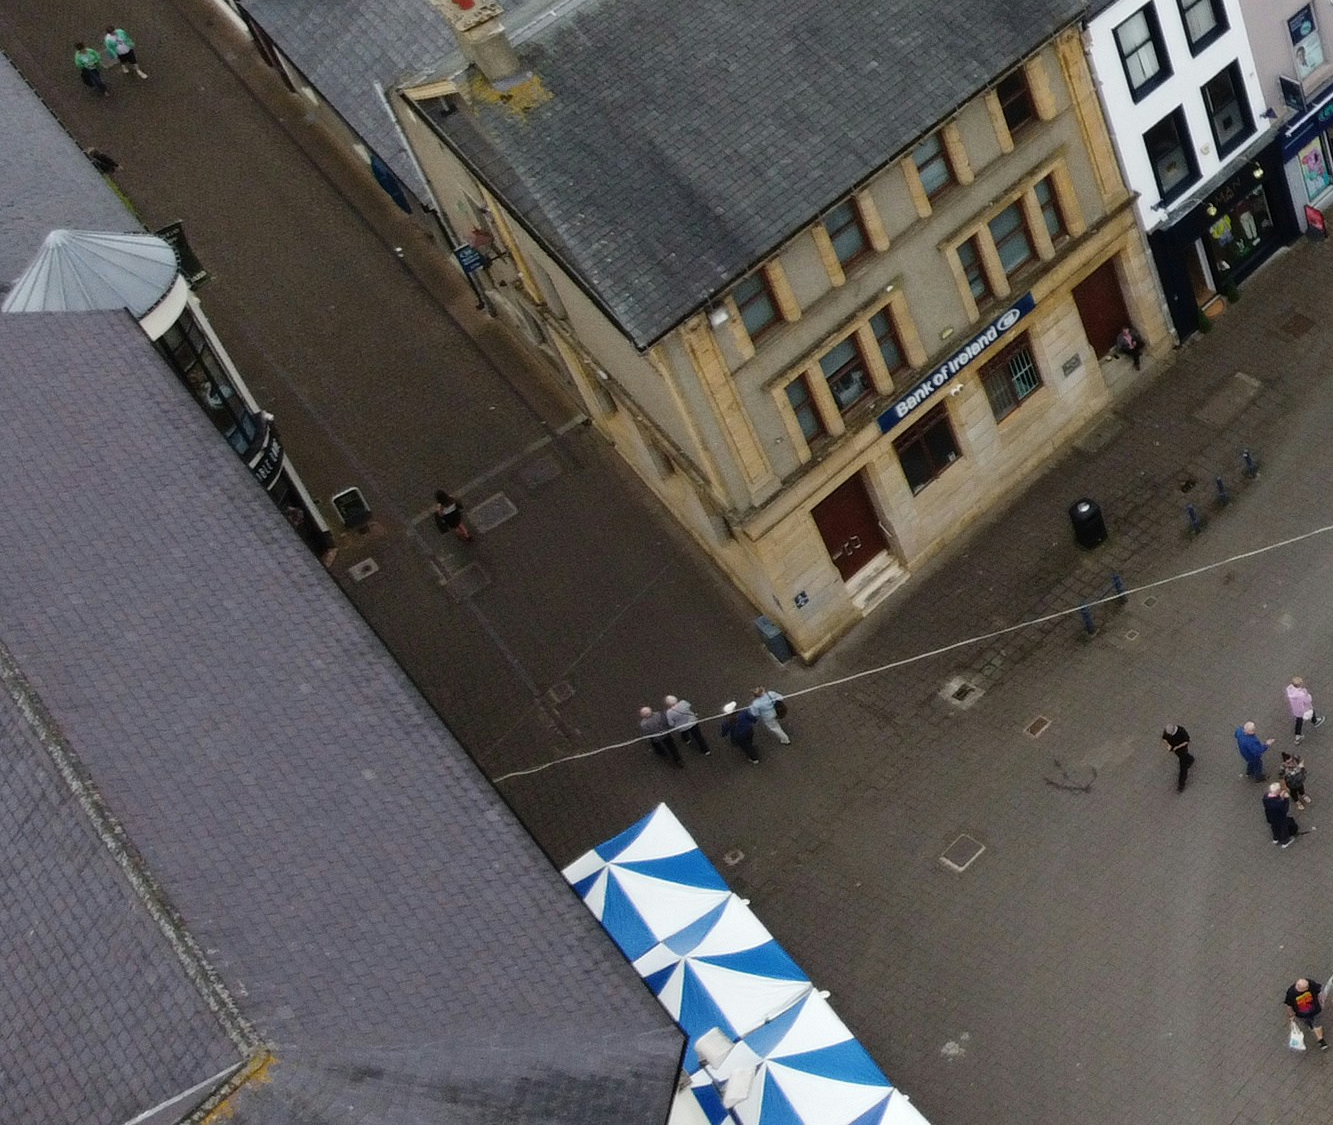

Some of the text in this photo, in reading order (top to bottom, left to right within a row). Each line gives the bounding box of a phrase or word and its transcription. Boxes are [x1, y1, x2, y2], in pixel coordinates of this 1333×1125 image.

[895, 326, 998, 418] Bank of Ireland
